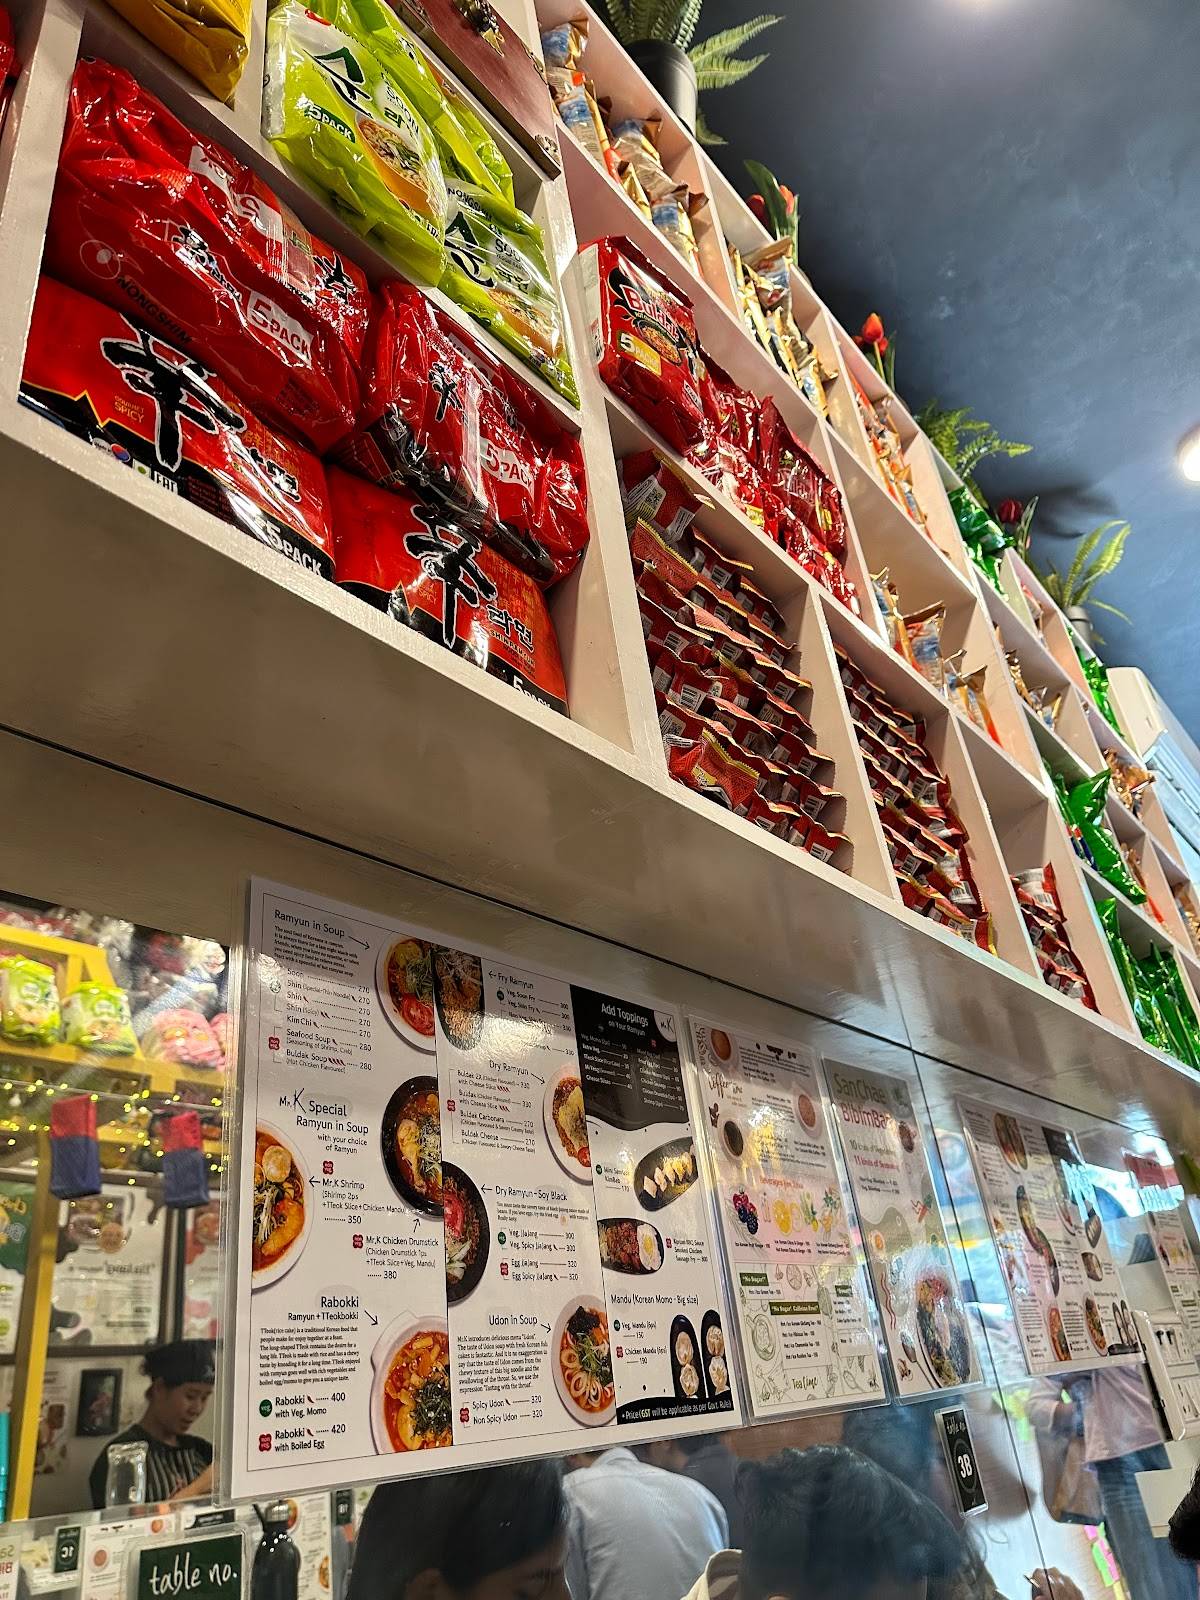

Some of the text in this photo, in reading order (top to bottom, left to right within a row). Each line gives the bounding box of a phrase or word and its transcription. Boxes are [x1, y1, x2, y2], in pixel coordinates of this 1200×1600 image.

[304, 103, 353, 141] 5PACK
[117, 274, 194, 344] NONGSHIM
[250, 297, 312, 359] 5PACK
[114, 403, 145, 424] SPICY
[265, 521, 322, 577] 5PACK
[486, 604, 534, 653] 라면
[275, 909, 345, 938] Ramyun in Soup
[287, 980, 302, 989] Shin
[510, 976, 533, 989] Ramyun
[287, 991, 371, 1016] Shin 270
[287, 1003, 371, 1027] Shin 270
[601, 1003, 649, 1027] Add Toppings
[286, 1028, 372, 1052] Seafood Soup 280
[359, 1029, 371, 1038] 270
[286, 1049, 372, 1071] Buldak Soup 280
[489, 1060, 529, 1075] Dry Ramyun
[834, 1073, 887, 1105] SanChae
[309, 1101, 347, 1116] Special
[297, 1116, 369, 1134] Ramyun in Soup
[318, 1133, 367, 1145] with your choice
[334, 1144, 357, 1154] Ramyun
[341, 1180, 365, 1190] Shrimp
[348, 1192, 359, 1200] 2ps
[496, 1186, 567, 1201] Dry Ramyun Soy Black
[348, 1216, 362, 1224] 350
[383, 1236, 407, 1245] Chicken
[409, 1237, 439, 1246] Drumstick
[391, 1248, 417, 1257] Drumstick
[511, 1258, 521, 1268] Egg
[384, 1271, 397, 1279] 380
[512, 1273, 521, 1281] Egg
[321, 1296, 359, 1308] Rabokki
[611, 1294, 632, 1304] Mandu
[633, 1294, 654, 1304] (Korean
[655, 1295, 672, 1304] Momo
[677, 1296, 686, 1306] Big
[288, 1312, 359, 1322] Ramyun TTeokbokki
[489, 1315, 538, 1326] Udon in Soup
[643, 1346, 656, 1354] Mandu
[275, 1392, 345, 1406] Rabokki 400
[472, 1402, 488, 1410] Spicy
[489, 1399, 504, 1408] Udon
[275, 1409, 290, 1418] with
[306, 1407, 327, 1415] Momo
[669, 1404, 692, 1415] applicable
[473, 1410, 543, 1425] Non Spicy Udon 320
[275, 1424, 345, 1440] Rabokki 420
[275, 1440, 325, 1452] with Boiled Egg
[958, 1454, 972, 1478] 3B
[149, 1552, 238, 1595] table no.
